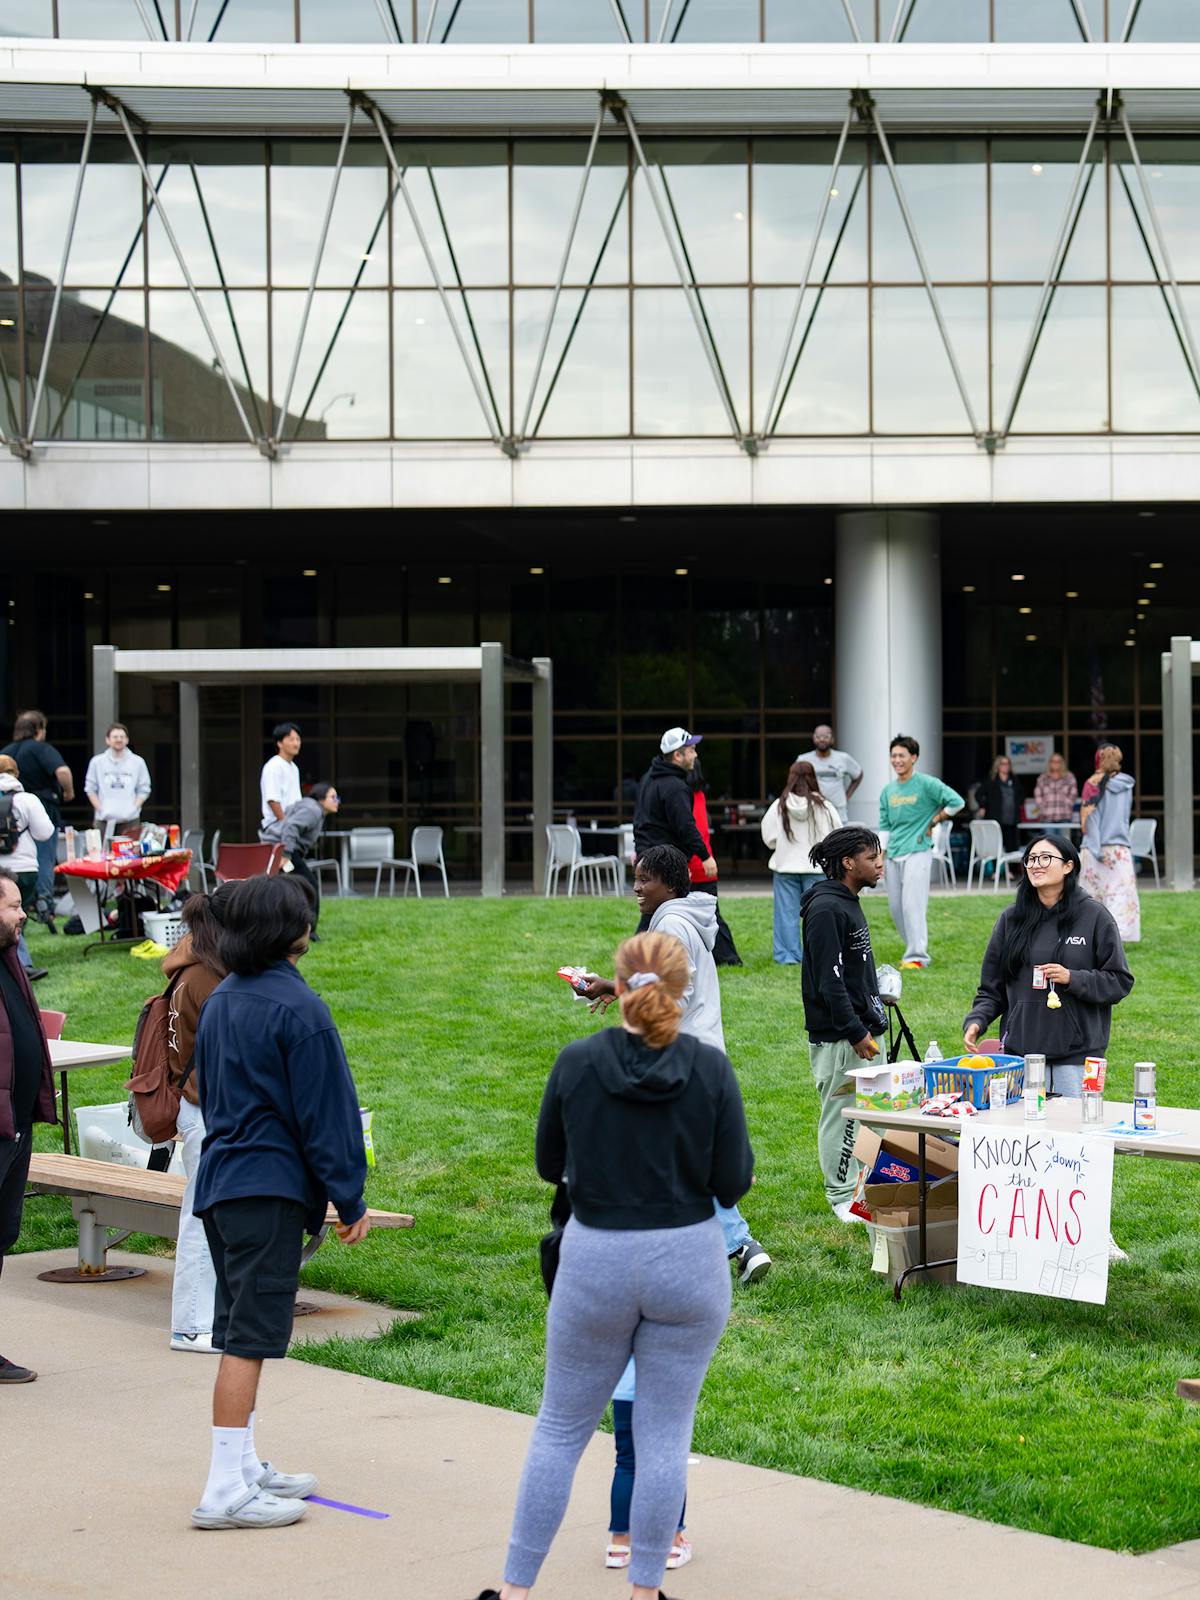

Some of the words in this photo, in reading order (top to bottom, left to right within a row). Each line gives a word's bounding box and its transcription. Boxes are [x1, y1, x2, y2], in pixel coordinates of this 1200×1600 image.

[1058, 936, 1087, 946] ASA
[843, 1118, 856, 1147] GAN
[972, 1135, 1041, 1172] KNOCK
[1052, 1151, 1081, 1172] down
[1005, 1172, 1036, 1188] the
[978, 1183, 1086, 1246] CANS
